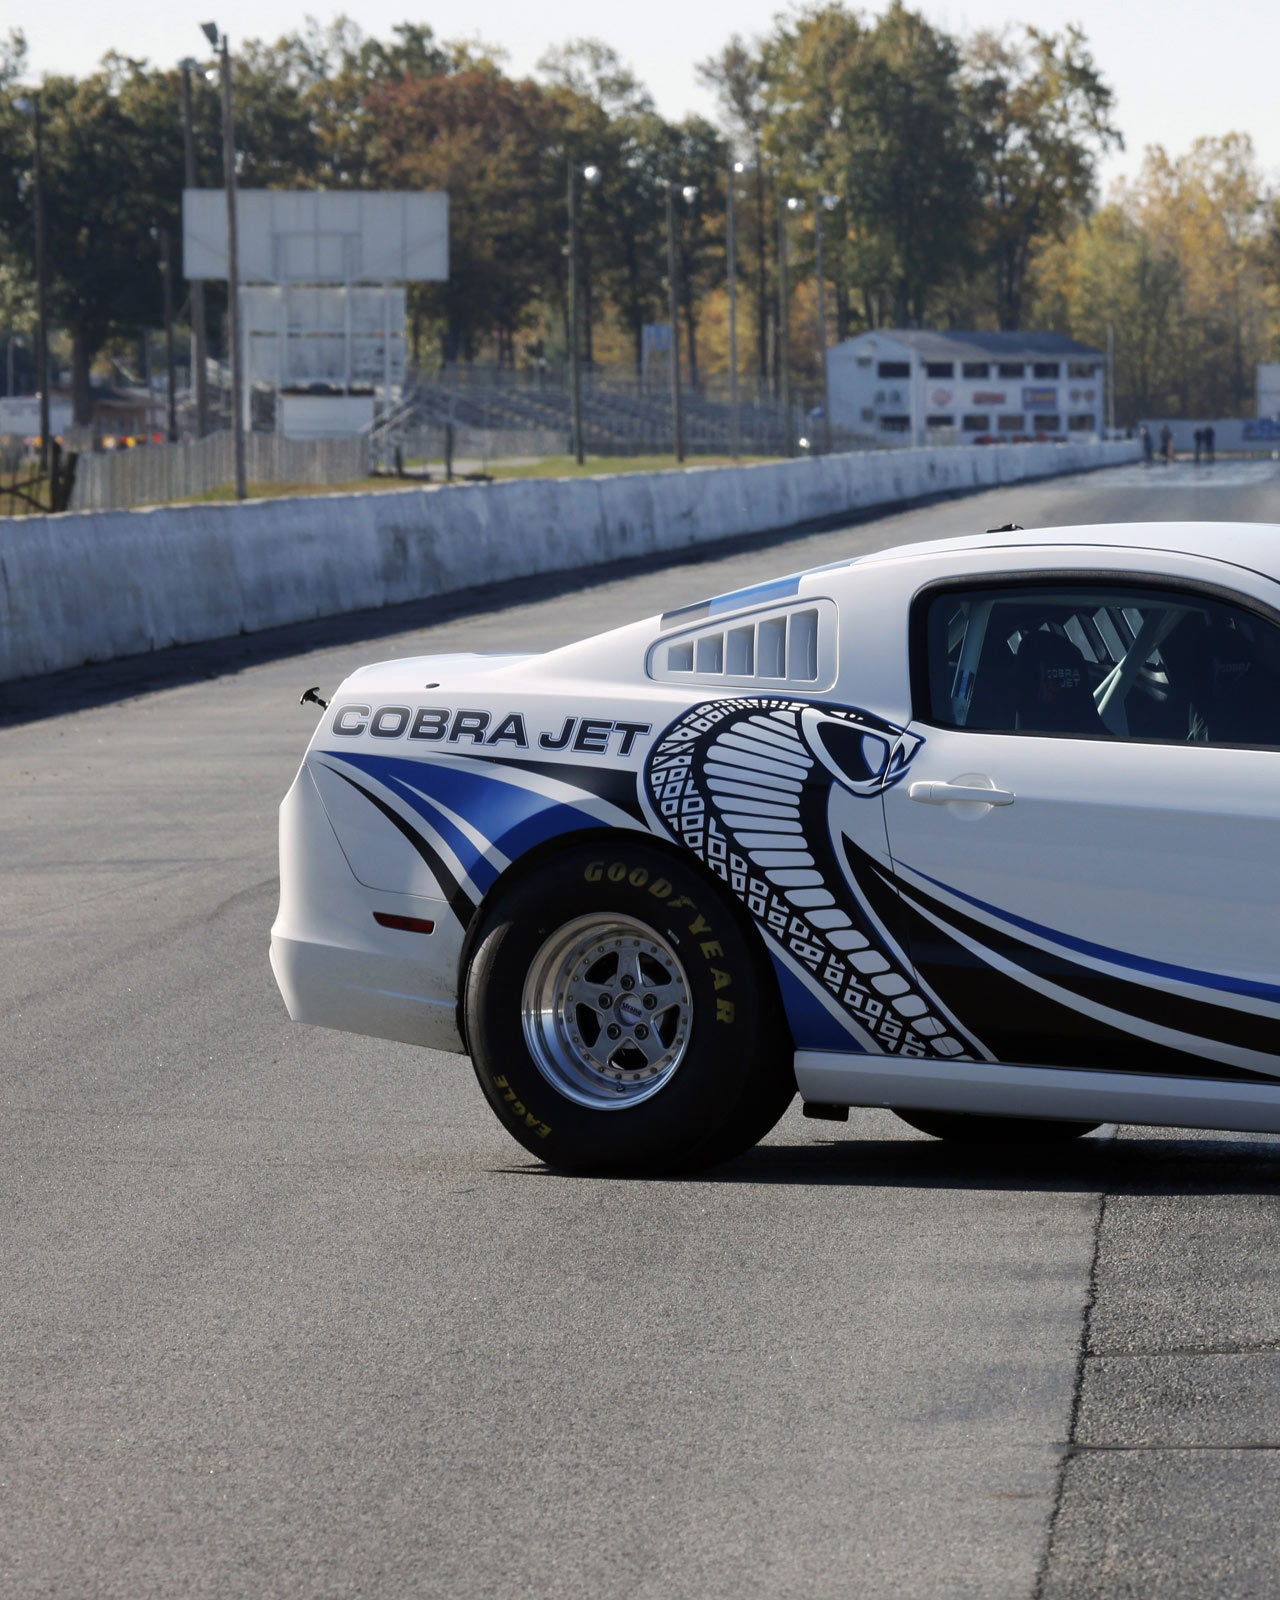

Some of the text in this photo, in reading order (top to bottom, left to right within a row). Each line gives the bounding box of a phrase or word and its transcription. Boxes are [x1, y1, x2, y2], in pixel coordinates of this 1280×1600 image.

[331, 704, 652, 757] COBRA JET
[492, 1075, 552, 1139] EAGLE
